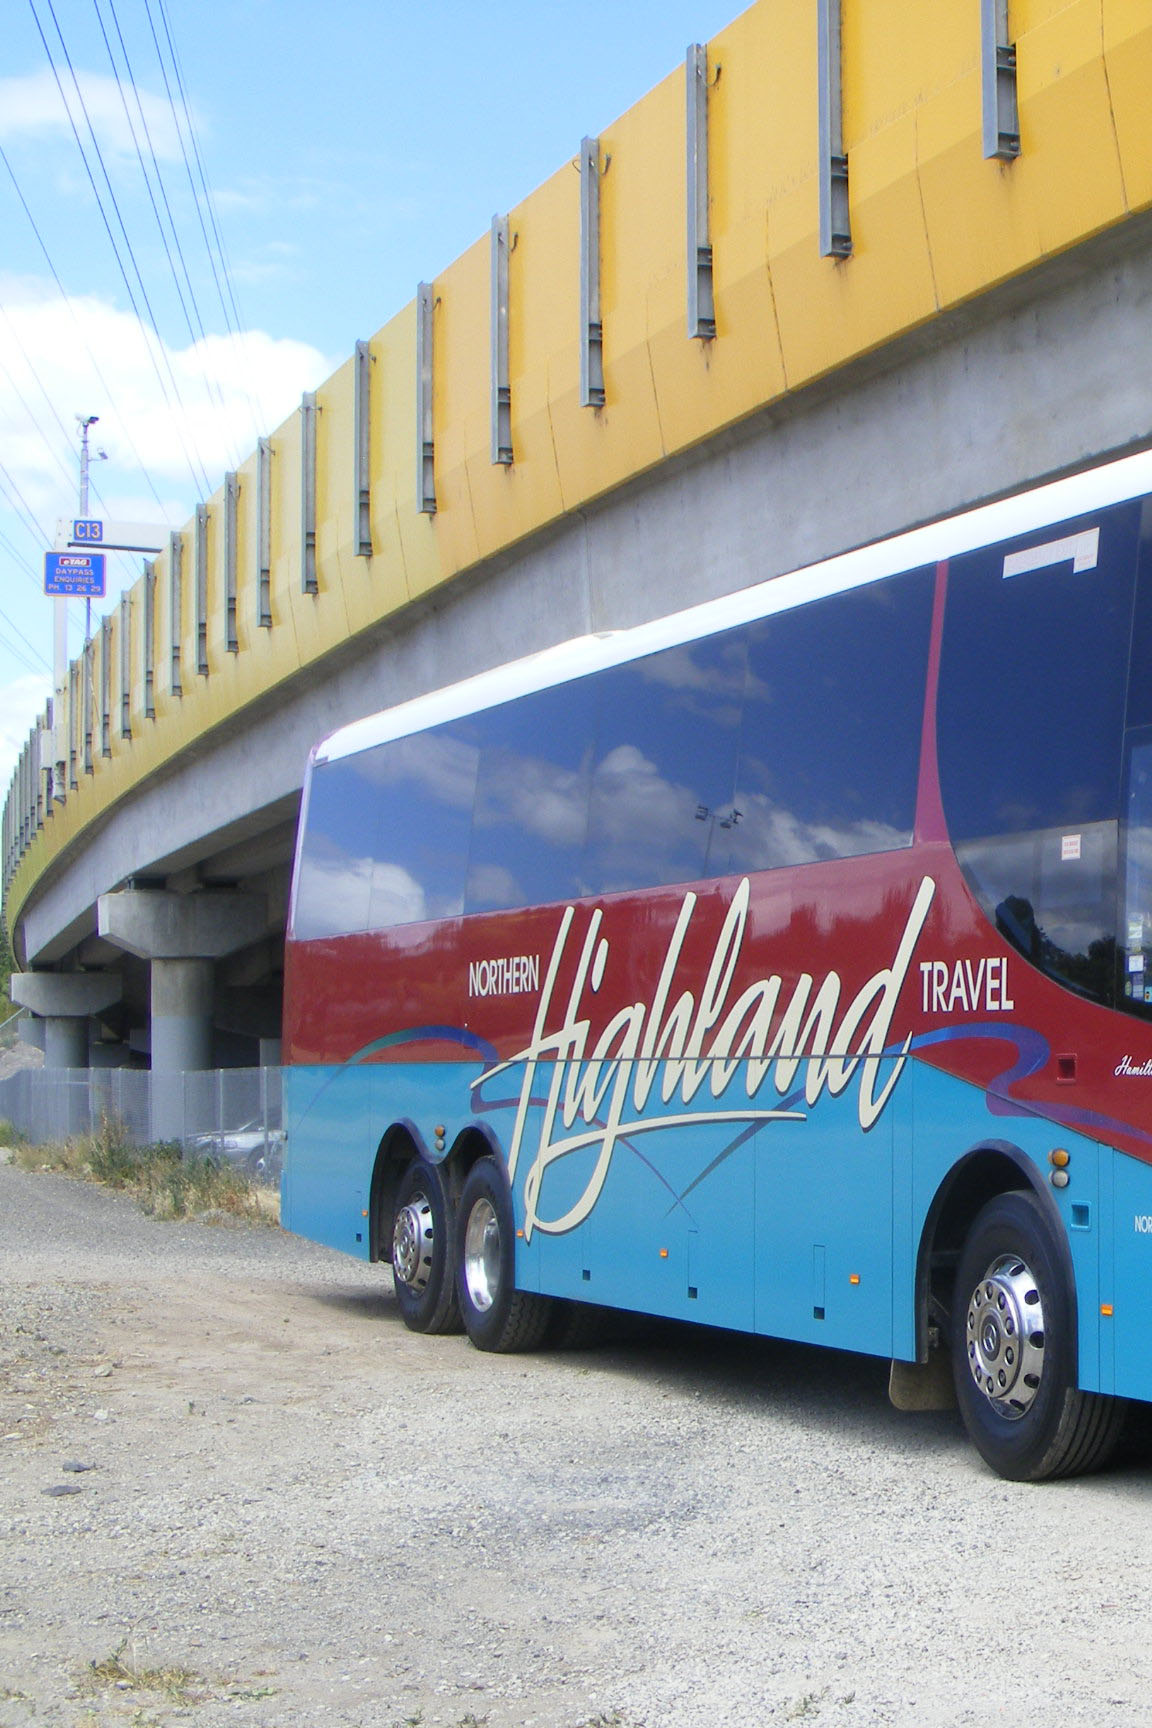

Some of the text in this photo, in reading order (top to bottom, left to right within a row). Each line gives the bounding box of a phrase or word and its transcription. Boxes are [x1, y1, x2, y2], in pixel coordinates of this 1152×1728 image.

[75, 523, 101, 539] C13
[468, 876, 1014, 1243] NORTHERN Highland TRAVEL
